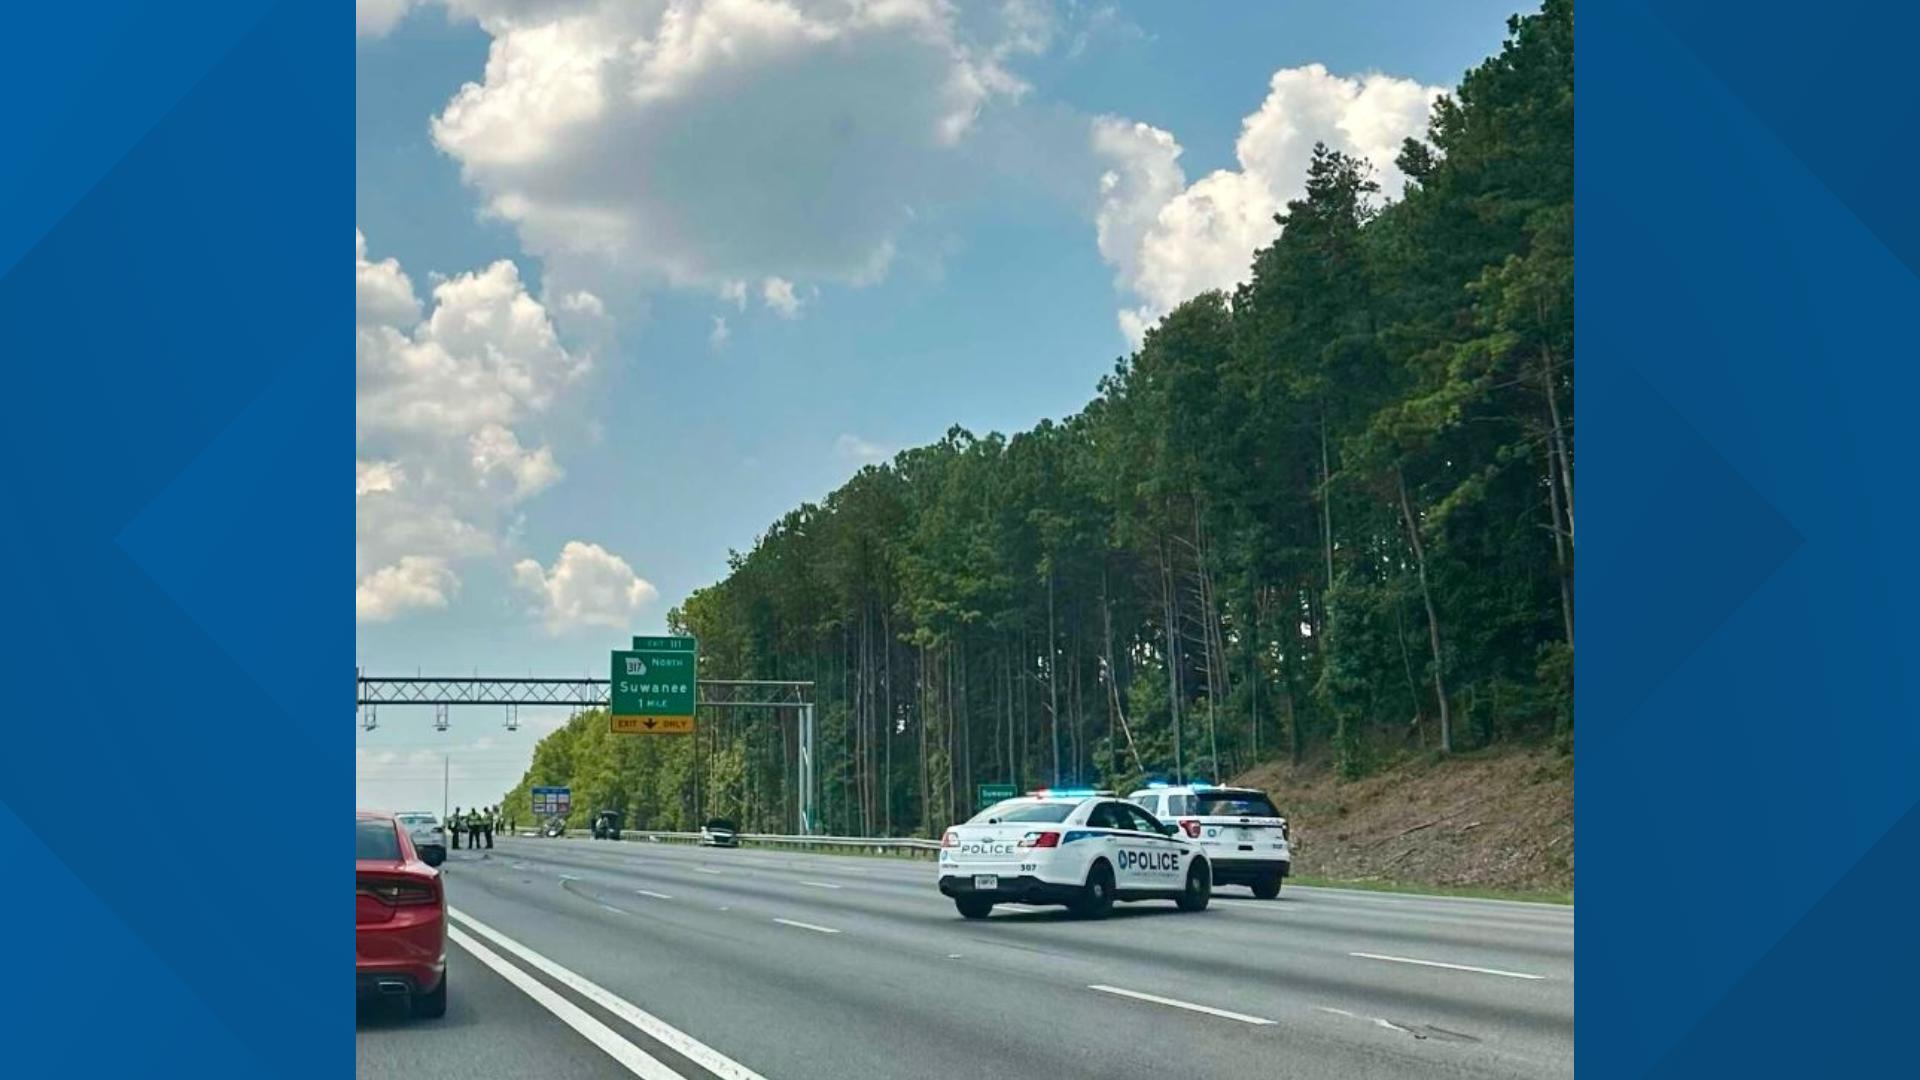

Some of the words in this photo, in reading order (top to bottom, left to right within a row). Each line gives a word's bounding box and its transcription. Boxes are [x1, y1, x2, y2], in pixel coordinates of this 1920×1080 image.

[647, 640, 664, 648] EXIT
[671, 640, 682, 649] 111
[651, 658, 684, 667] NORTH
[627, 662, 642, 673] 317
[620, 681, 688, 693] Suwanee
[647, 700, 668, 708] MILE
[618, 720, 637, 728] EXIT
[663, 720, 687, 728] ONLY
[961, 844, 1015, 854] POLICE
[1128, 851, 1180, 870] POLICE
